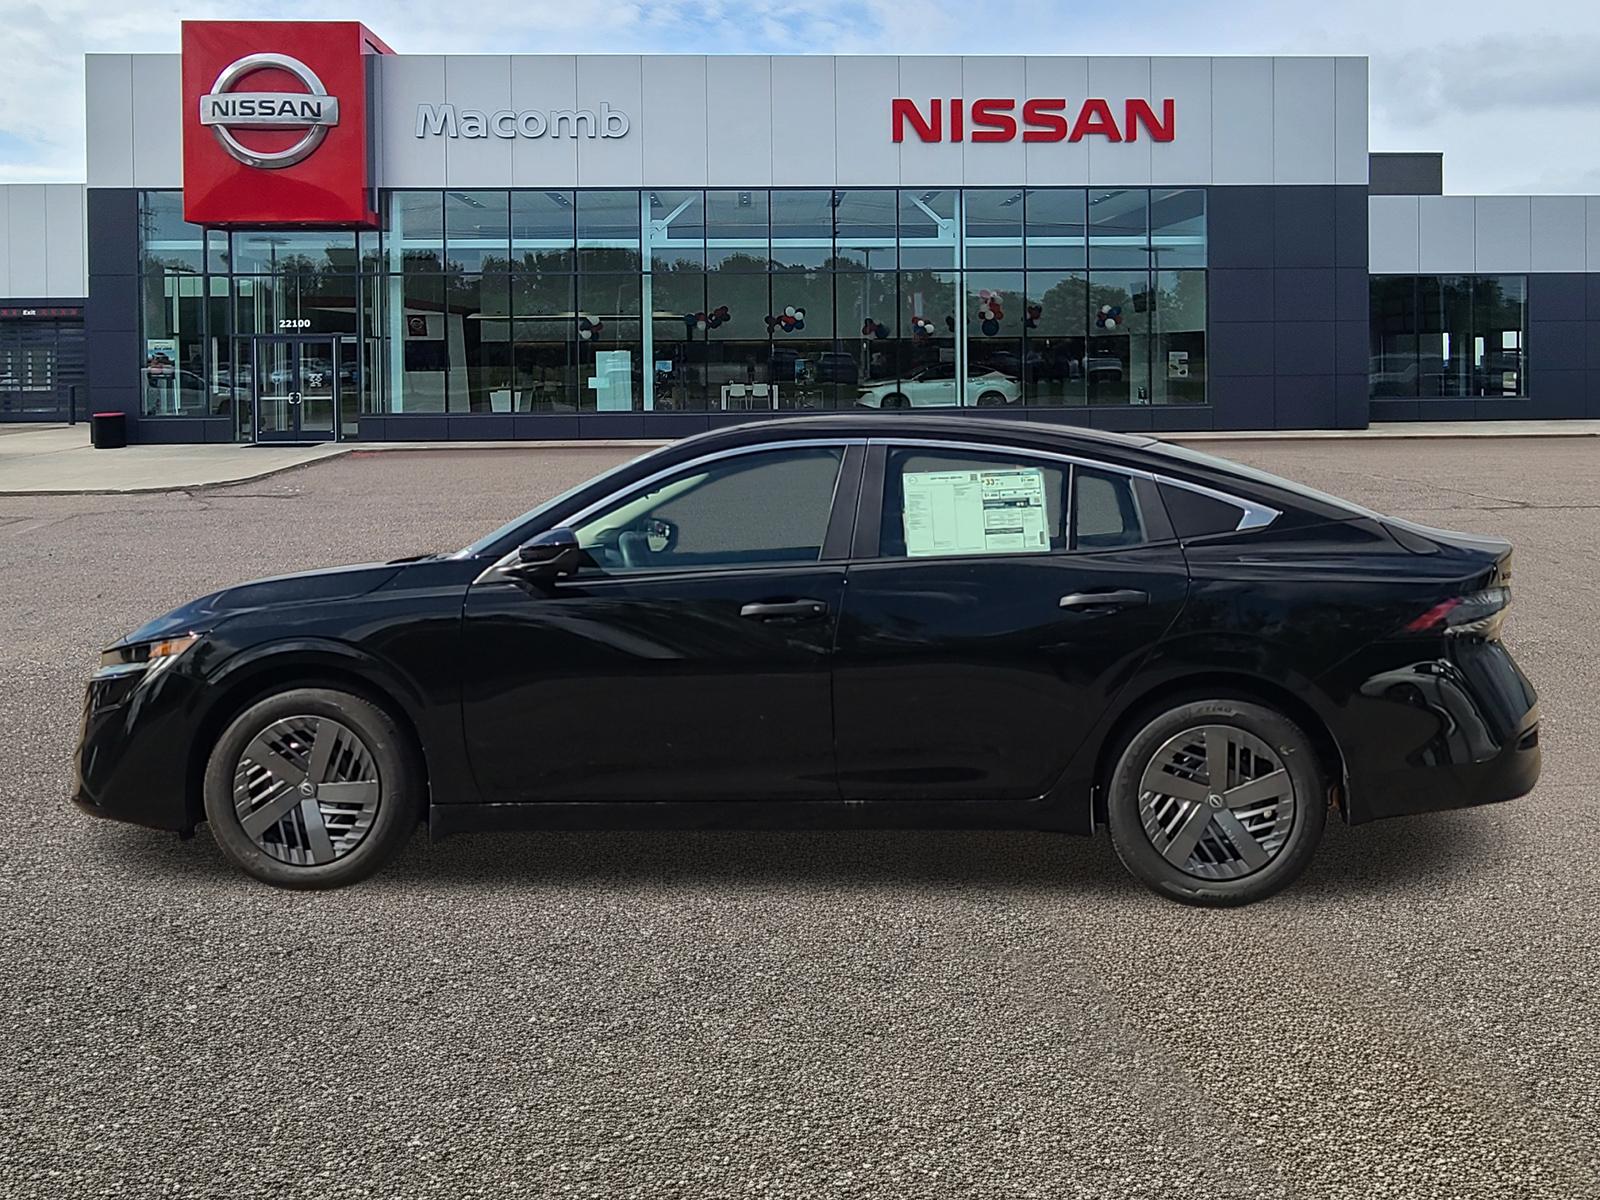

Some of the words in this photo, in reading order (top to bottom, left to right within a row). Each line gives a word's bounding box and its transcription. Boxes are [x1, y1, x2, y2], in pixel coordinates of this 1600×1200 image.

[212, 100, 322, 118] NISSAN
[415, 102, 630, 139] Macomb
[892, 98, 1175, 143] NISSAN
[279, 319, 311, 328] 22100
